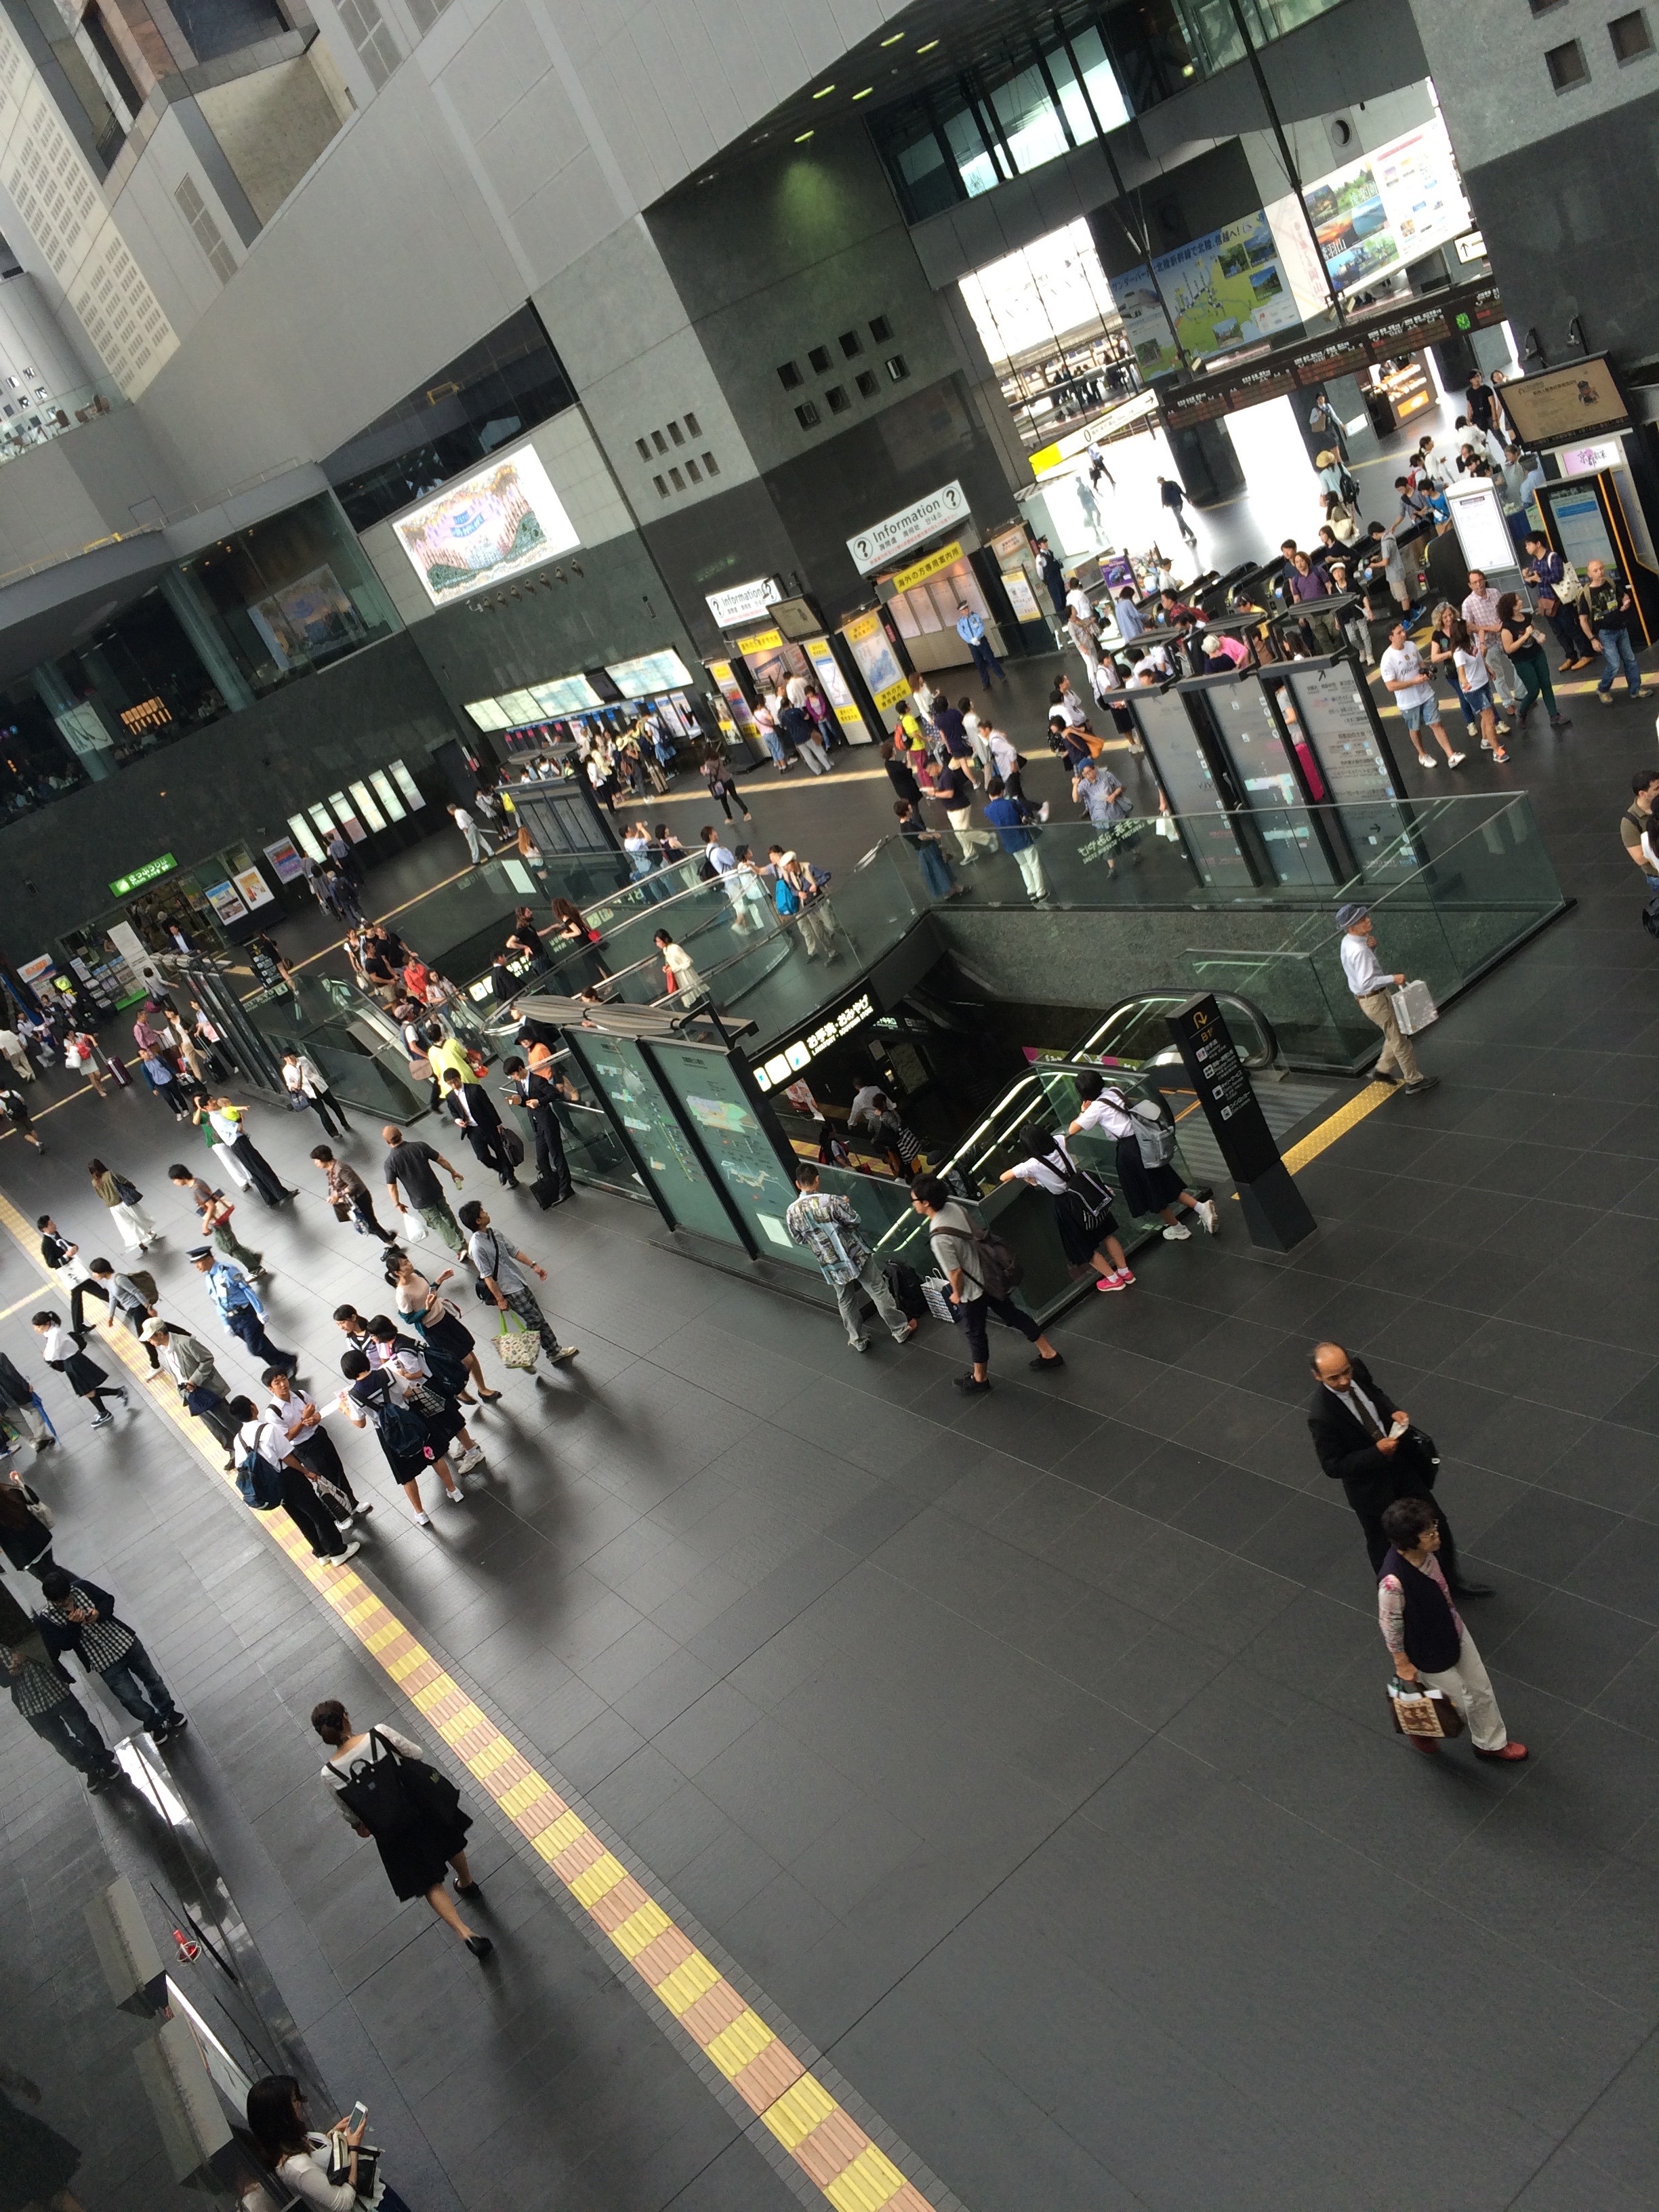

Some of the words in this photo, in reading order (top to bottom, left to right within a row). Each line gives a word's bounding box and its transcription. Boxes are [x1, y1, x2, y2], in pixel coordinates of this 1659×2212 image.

[872, 499, 941, 543] Information
[897, 548, 960, 587] 海外の方専用案内所
[721, 588, 764, 607] Information
[811, 1035, 836, 1057] LAVATORY
